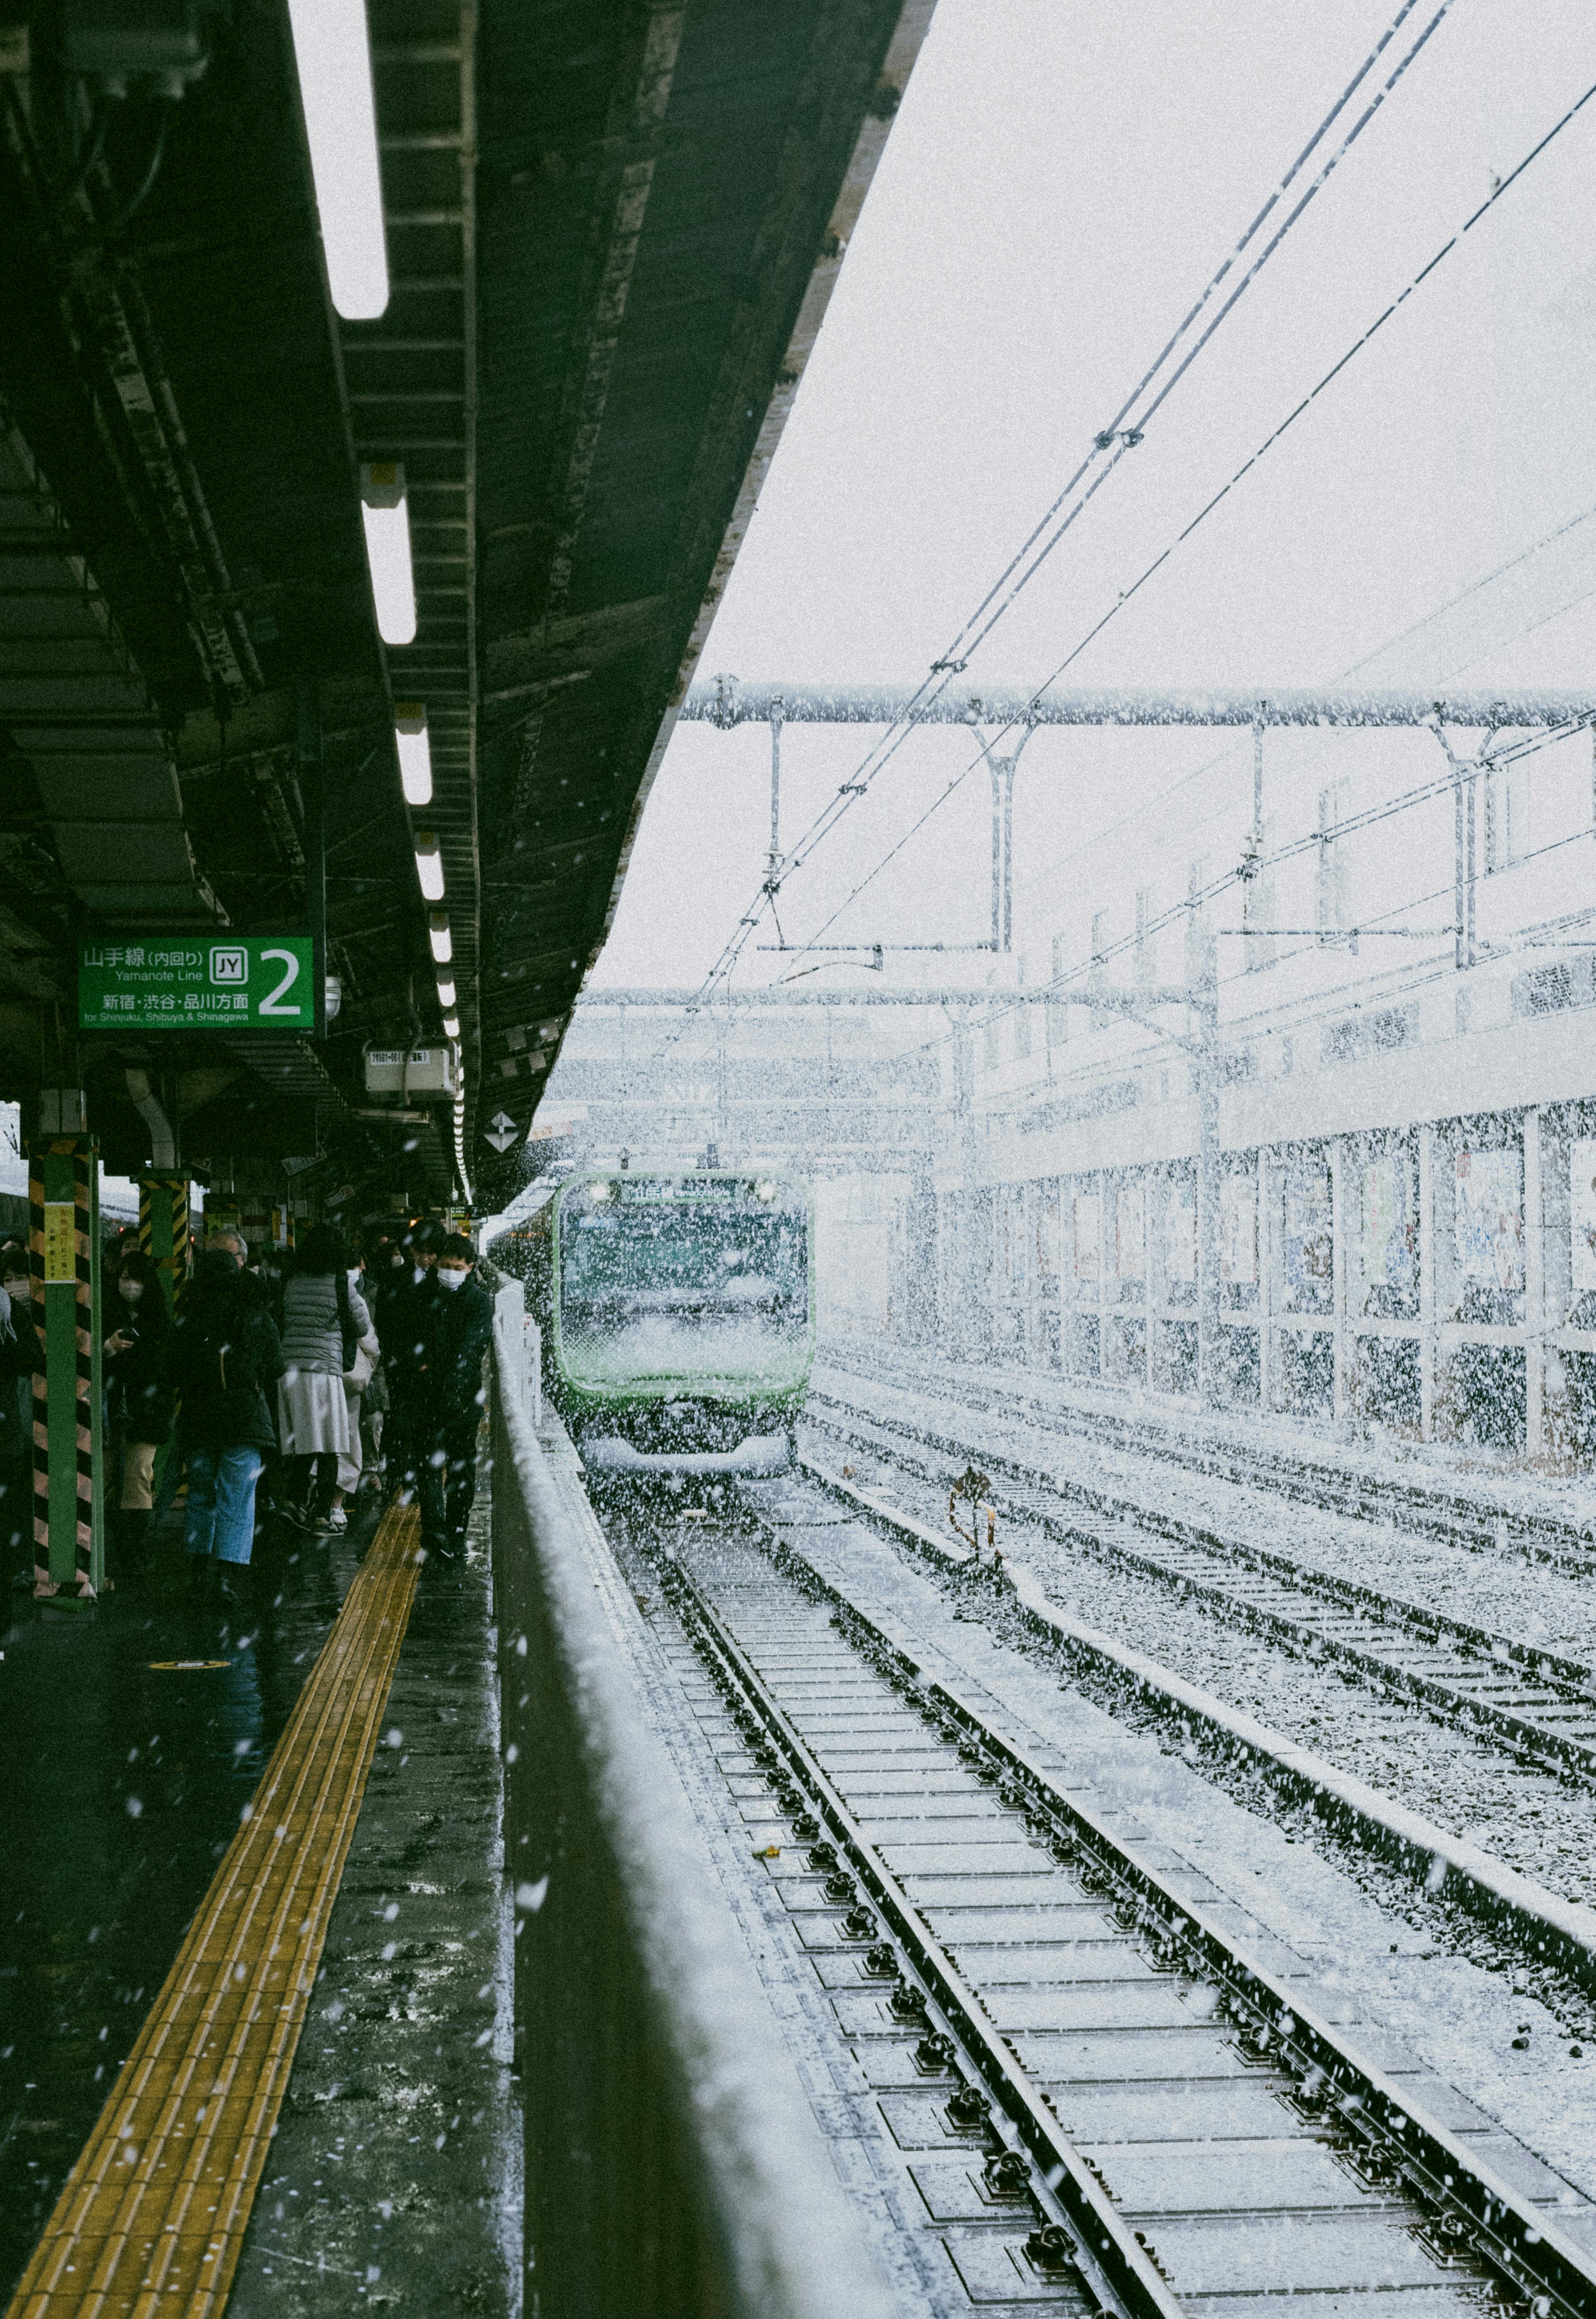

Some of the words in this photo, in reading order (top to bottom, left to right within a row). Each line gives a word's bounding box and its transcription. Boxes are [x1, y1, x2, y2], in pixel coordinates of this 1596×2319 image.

[219, 958, 239, 973] JY
[115, 970, 174, 981] Yamanote
[177, 970, 203, 981] Line
[258, 949, 301, 1015] 2
[84, 1013, 96, 1022] for
[145, 1013, 184, 1023] Shibuya
[197, 1012, 248, 1023] Shinagawa
